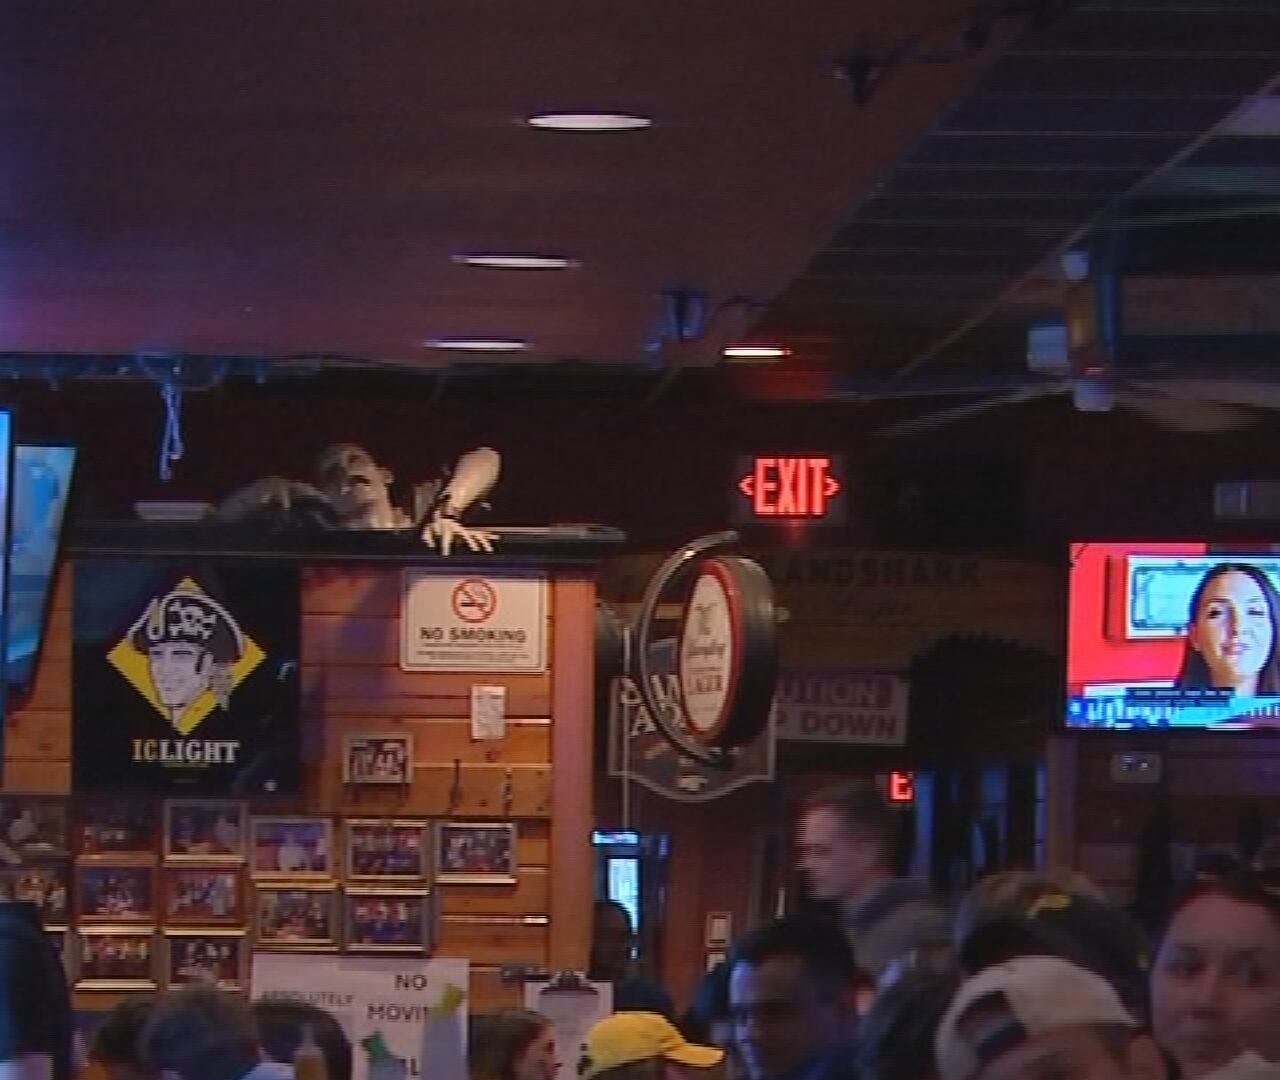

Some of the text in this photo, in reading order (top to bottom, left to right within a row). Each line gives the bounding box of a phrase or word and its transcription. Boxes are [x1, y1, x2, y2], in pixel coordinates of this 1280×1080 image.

[753, 455, 831, 517] EXIT
[419, 627, 527, 643] NO SMOKING
[777, 676, 877, 707] UTION
[801, 710, 897, 737] DOWN
[394, 974, 428, 991] NO
[366, 1004, 429, 1023] MOVI
